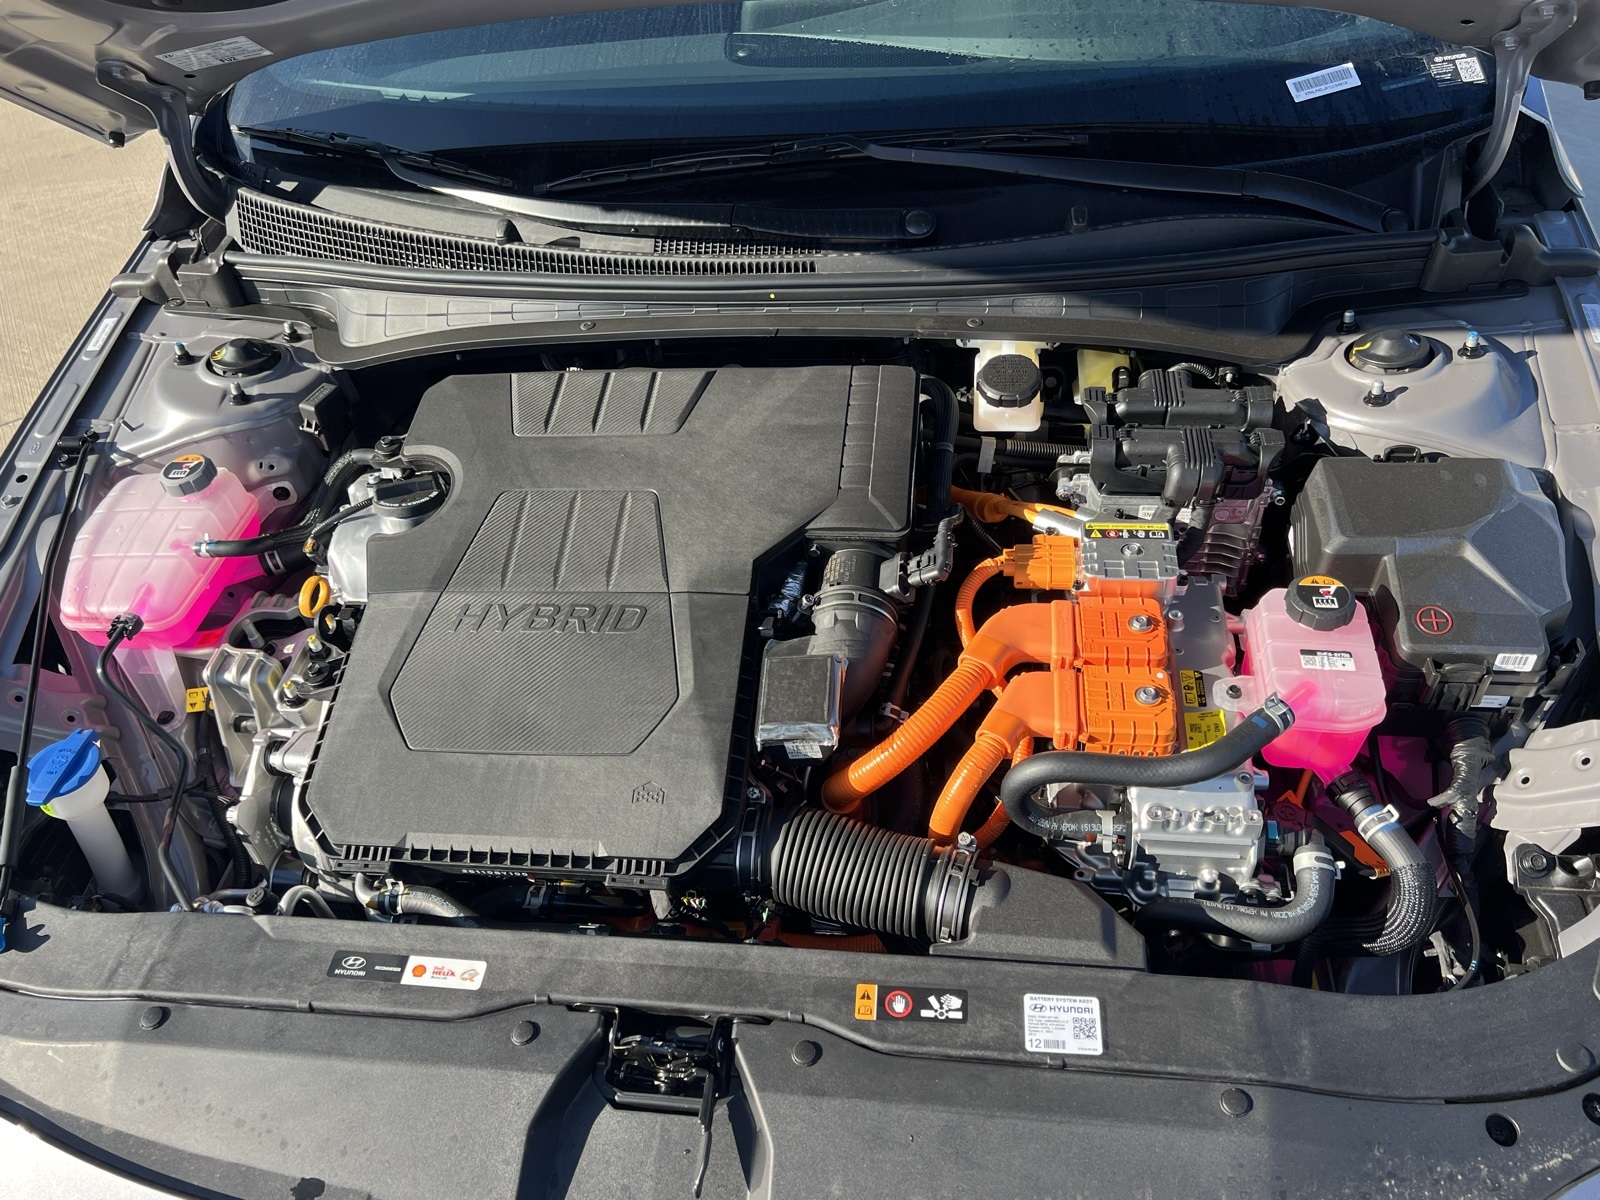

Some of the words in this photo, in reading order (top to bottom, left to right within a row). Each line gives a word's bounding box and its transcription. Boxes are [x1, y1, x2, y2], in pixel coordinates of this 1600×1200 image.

[448, 603, 648, 634] HYBRID
[334, 968, 366, 976] HYUNDAI
[432, 969, 456, 977] HELIX
[1049, 1005, 1094, 1014] HYUNDAI
[1028, 1038, 1042, 1049] 12
